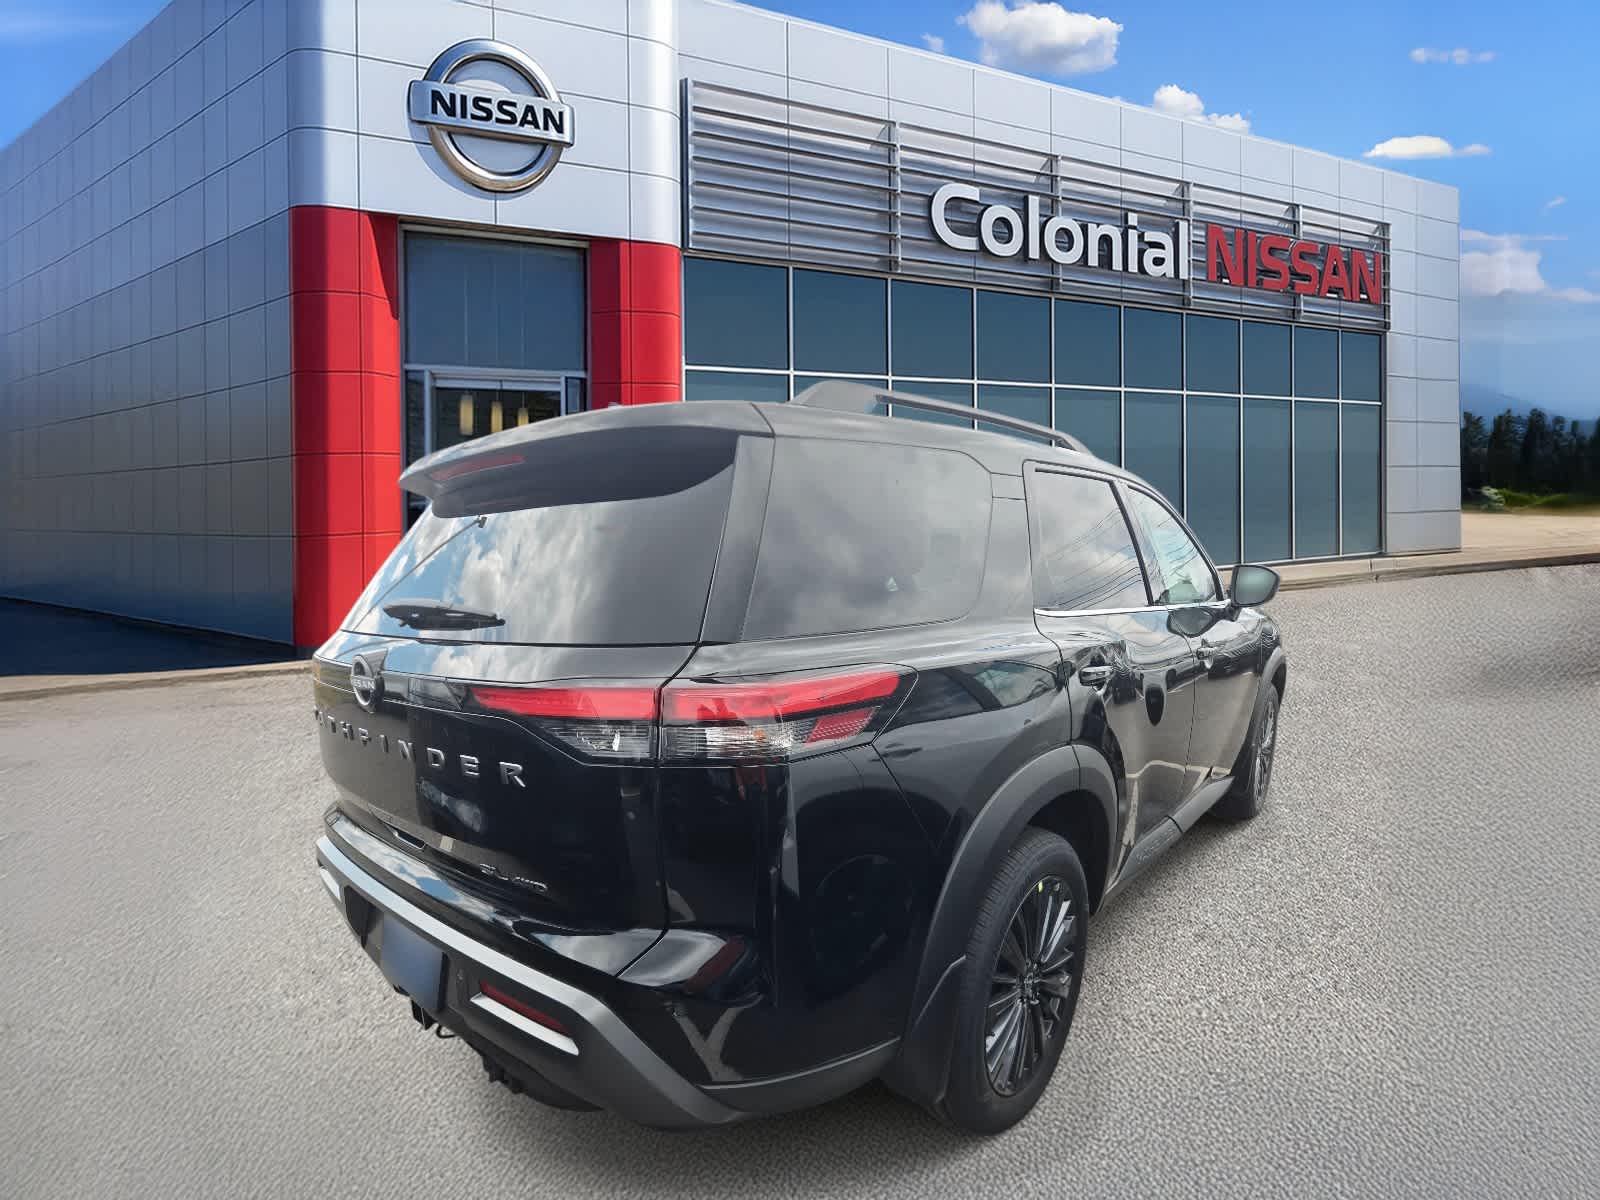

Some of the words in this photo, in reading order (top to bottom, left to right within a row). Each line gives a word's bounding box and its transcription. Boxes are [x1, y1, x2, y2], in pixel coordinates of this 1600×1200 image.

[431, 90, 564, 134] NISSAN
[931, 184, 1189, 280] Colonial
[1207, 224, 1382, 304] NISSAN
